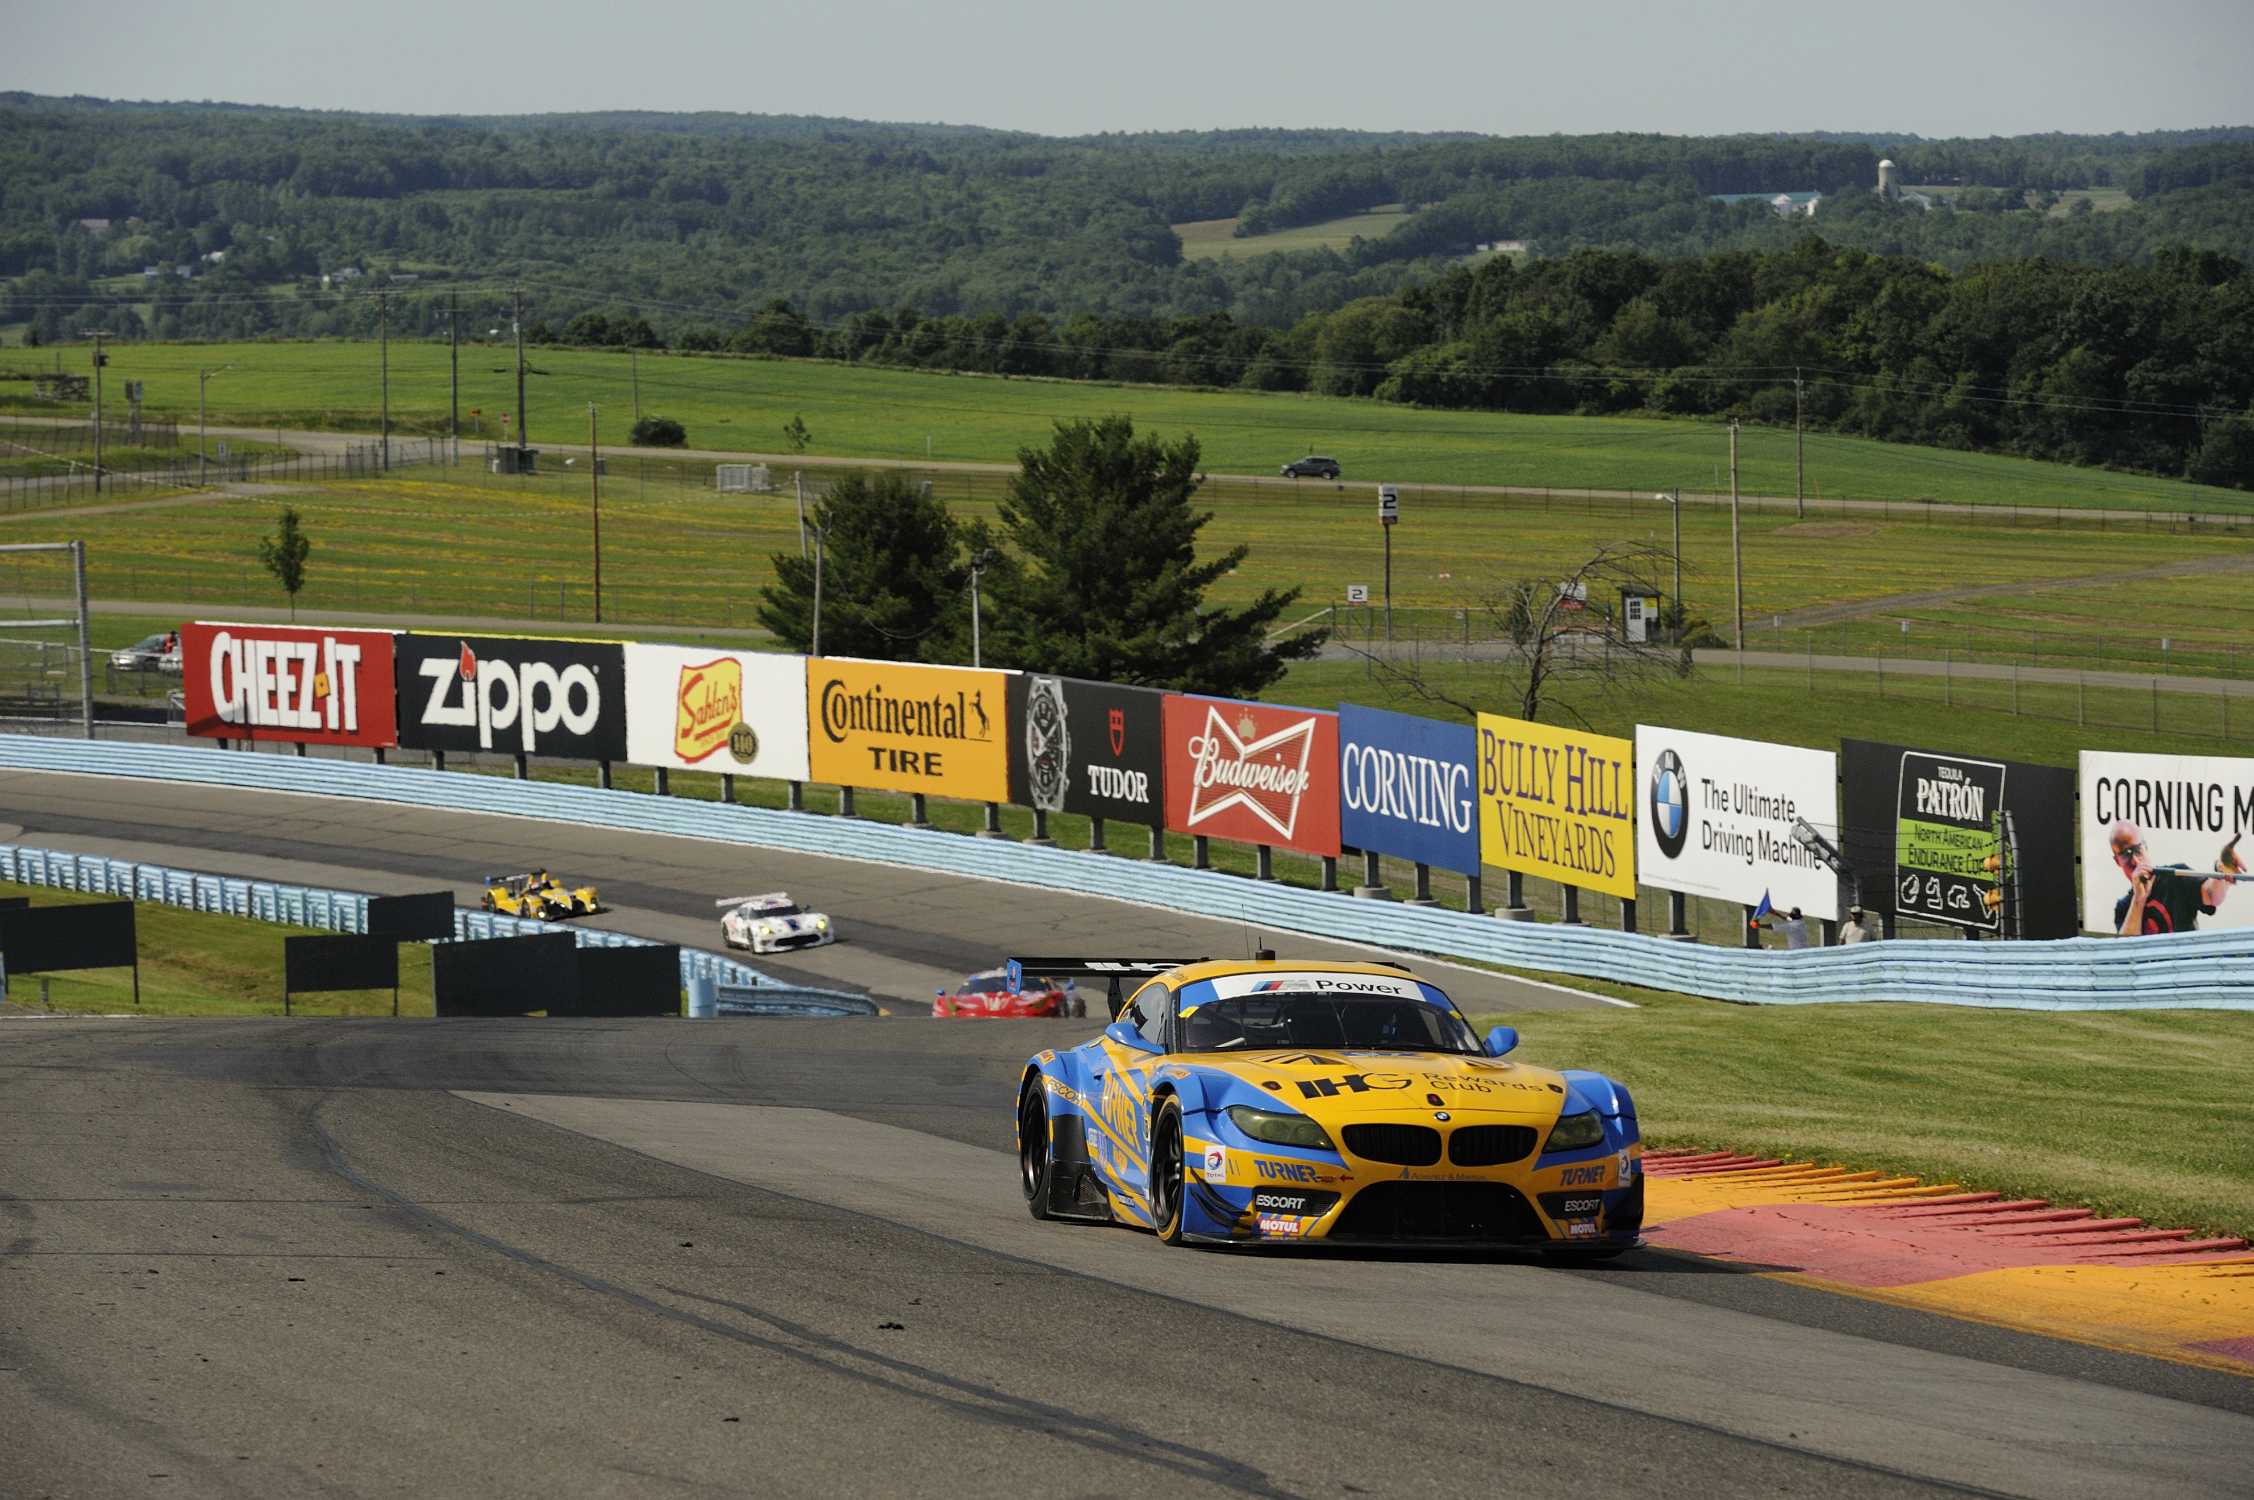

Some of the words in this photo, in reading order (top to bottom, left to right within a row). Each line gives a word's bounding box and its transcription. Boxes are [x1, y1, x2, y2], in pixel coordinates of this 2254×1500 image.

[1383, 493, 1397, 509] 2
[1351, 589, 1363, 600] 2
[821, 677, 967, 744] Continental
[867, 746, 944, 778] TIRE
[1187, 735, 1309, 794] Budweiser
[1482, 728, 1559, 805] BULLY
[1564, 744, 1628, 820] HILL
[1937, 766, 1963, 781] TEQUILA
[1087, 764, 1150, 804] TUDOR
[1342, 742, 1473, 834] CORNING
[1701, 778, 1729, 812] The
[1734, 783, 1795, 823] Ultimate
[1916, 777, 1985, 822] PATRÓN
[2096, 777, 2224, 833] CORNING
[1496, 800, 1615, 878] VINEYARDS
[1702, 819, 1754, 866] Driving
[1316, 979, 1402, 995] Power
[1296, 1072, 1412, 1099] IHG
[1422, 1072, 1544, 1092] Rewards
[1430, 1080, 1493, 1093] Club
[1254, 1159, 1316, 1183] TURNER
[1560, 1165, 1605, 1187] TURNER
[1255, 1194, 1306, 1210] ESCORT
[1564, 1199, 1601, 1212] ESCORT
[1259, 1219, 1299, 1233] MOTUL
